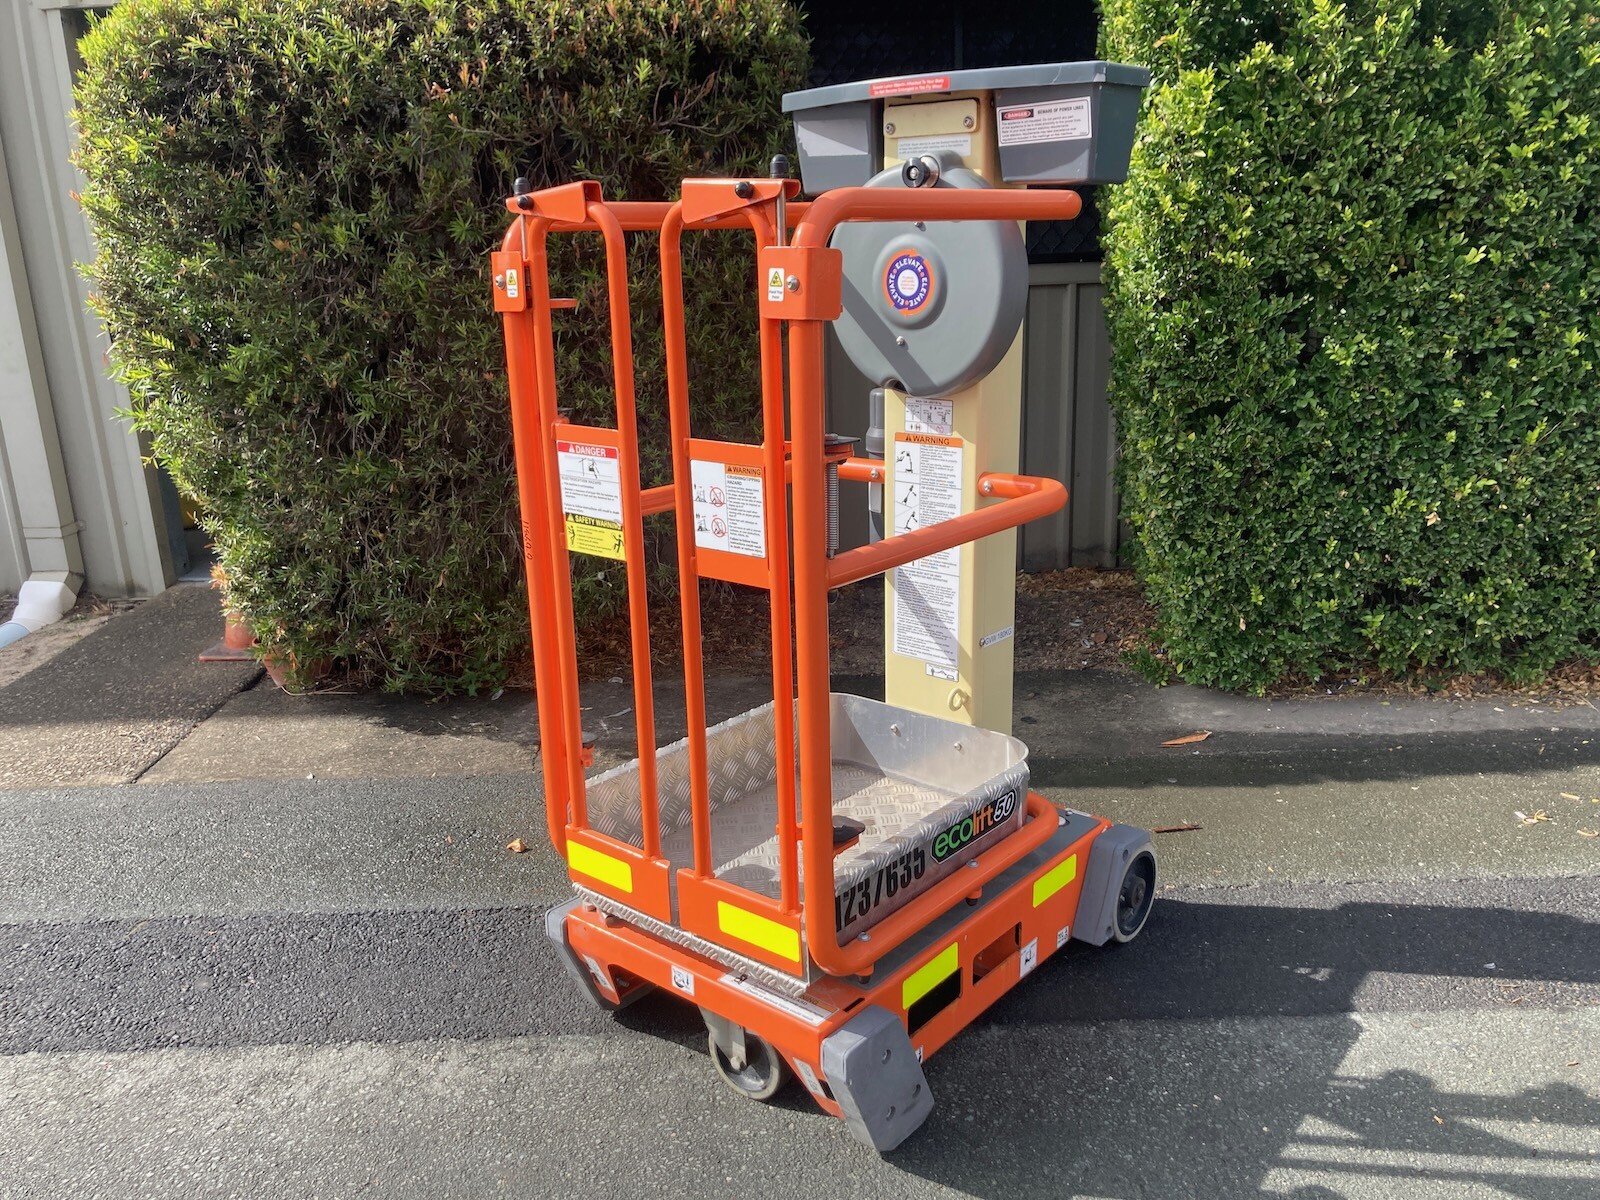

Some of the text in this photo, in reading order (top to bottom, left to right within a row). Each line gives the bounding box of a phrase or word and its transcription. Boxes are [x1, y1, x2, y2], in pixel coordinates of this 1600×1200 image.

[895, 257, 923, 272] ELEVATE
[889, 272, 905, 306] ELEVATE
[909, 277, 928, 306] ELEVATE
[913, 435, 950, 445] WARNING
[575, 445, 607, 457] DANGER
[732, 466, 761, 476] WARNING
[575, 514, 595, 526] SAFETY
[935, 791, 1015, 857] ecolift 50
